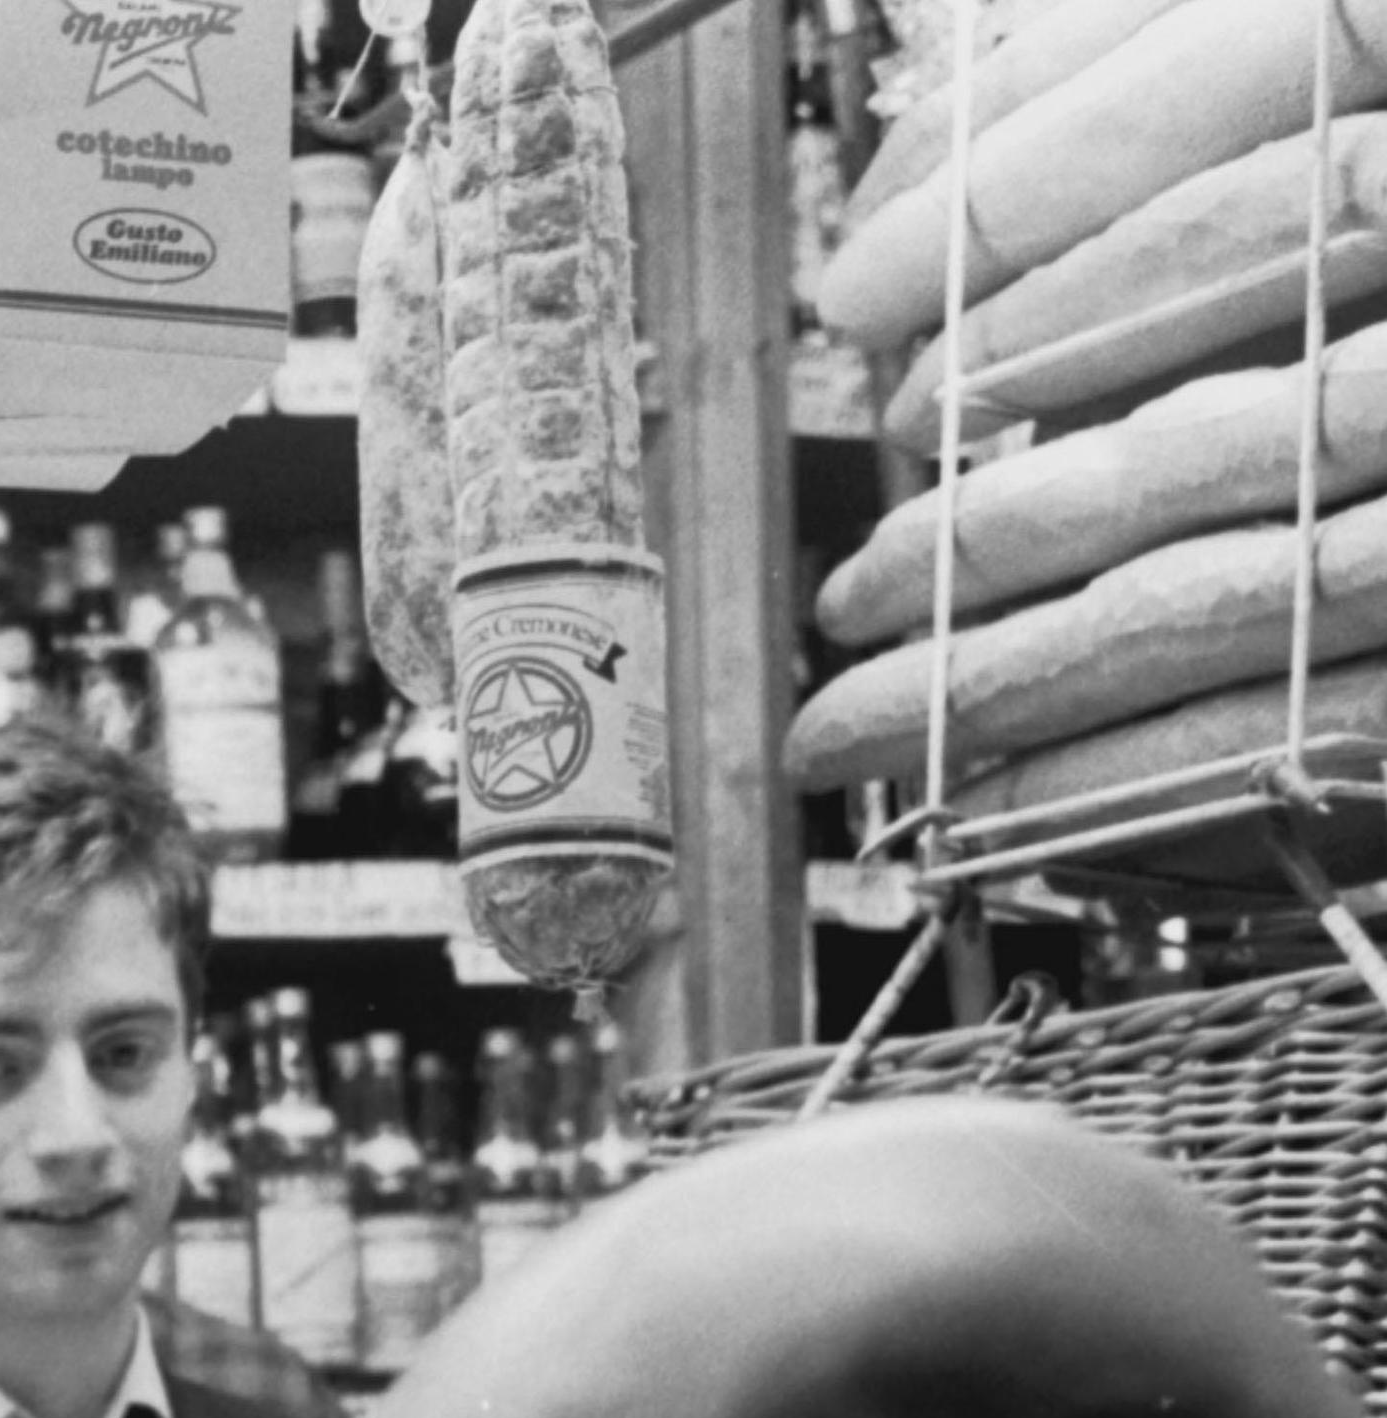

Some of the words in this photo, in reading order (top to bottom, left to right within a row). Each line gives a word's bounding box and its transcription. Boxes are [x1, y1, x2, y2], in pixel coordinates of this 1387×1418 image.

[61, 11, 236, 52] Negroni
[56, 130, 233, 166] cotechino
[101, 152, 195, 190] lampo
[106, 218, 184, 243] Gusto
[89, 239, 208, 266] Emiliano
